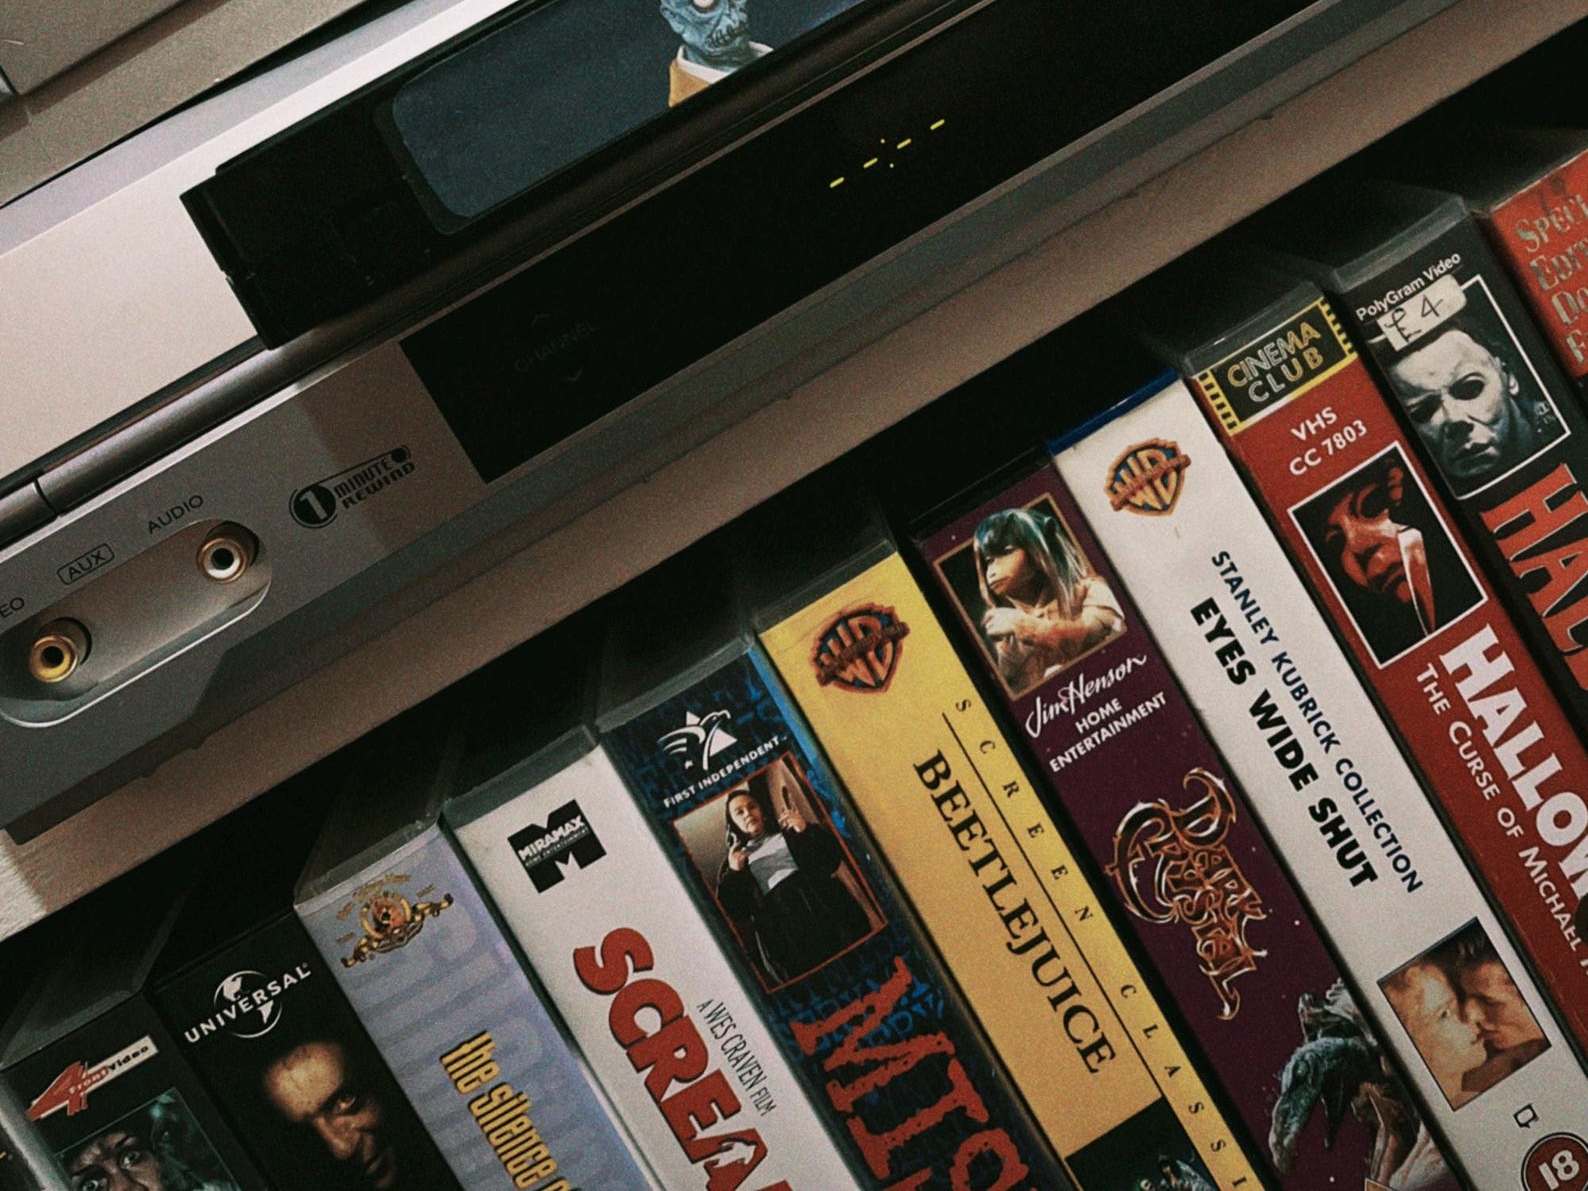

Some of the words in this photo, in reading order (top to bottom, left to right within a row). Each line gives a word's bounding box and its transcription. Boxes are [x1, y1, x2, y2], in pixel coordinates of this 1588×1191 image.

[1355, 276, 1425, 321] PolyGram
[1422, 252, 1461, 281] Video
[1227, 321, 1322, 388] CINEMA
[1248, 346, 1324, 402] CLUB
[1288, 448, 1322, 476] CC
[1321, 419, 1368, 456] 7803
[1290, 406, 1338, 442] VHS
[333, 457, 393, 500] MINUTE
[148, 494, 204, 534] AUDIO
[68, 550, 107, 580] AUX
[1048, 690, 1168, 773] ENTERTAINMENT
[1074, 697, 1123, 734] HOME
[1190, 596, 1257, 686] EYES
[1247, 689, 1319, 793] WIDE
[1308, 797, 1379, 888] SHUT
[1211, 550, 1279, 646] STANLEY
[1271, 650, 1341, 756] KUBRICK
[1335, 757, 1424, 894] COLLECTION
[663, 785, 696, 809] FIRST
[698, 735, 781, 790] INDEPENDENT
[1439, 624, 1588, 902] HALLO
[954, 698, 1095, 923] SCREEN
[1415, 662, 1451, 716] THE
[1447, 720, 1500, 801] CURSE
[1496, 807, 1525, 839] OF
[1518, 846, 1582, 952] MICHAEL
[517, 814, 585, 861] MIRAMAX
[912, 749, 1118, 1075] BEETLEJUICE
[184, 964, 312, 1044] UNIVERSAL
[696, 998, 715, 1013] A
[703, 1001, 737, 1040] WES
[573, 927, 793, 1191] SCREA
[720, 1034, 768, 1093] CRAVEN
[749, 1085, 778, 1117] FILM
[1538, 1149, 1580, 1191] 18
